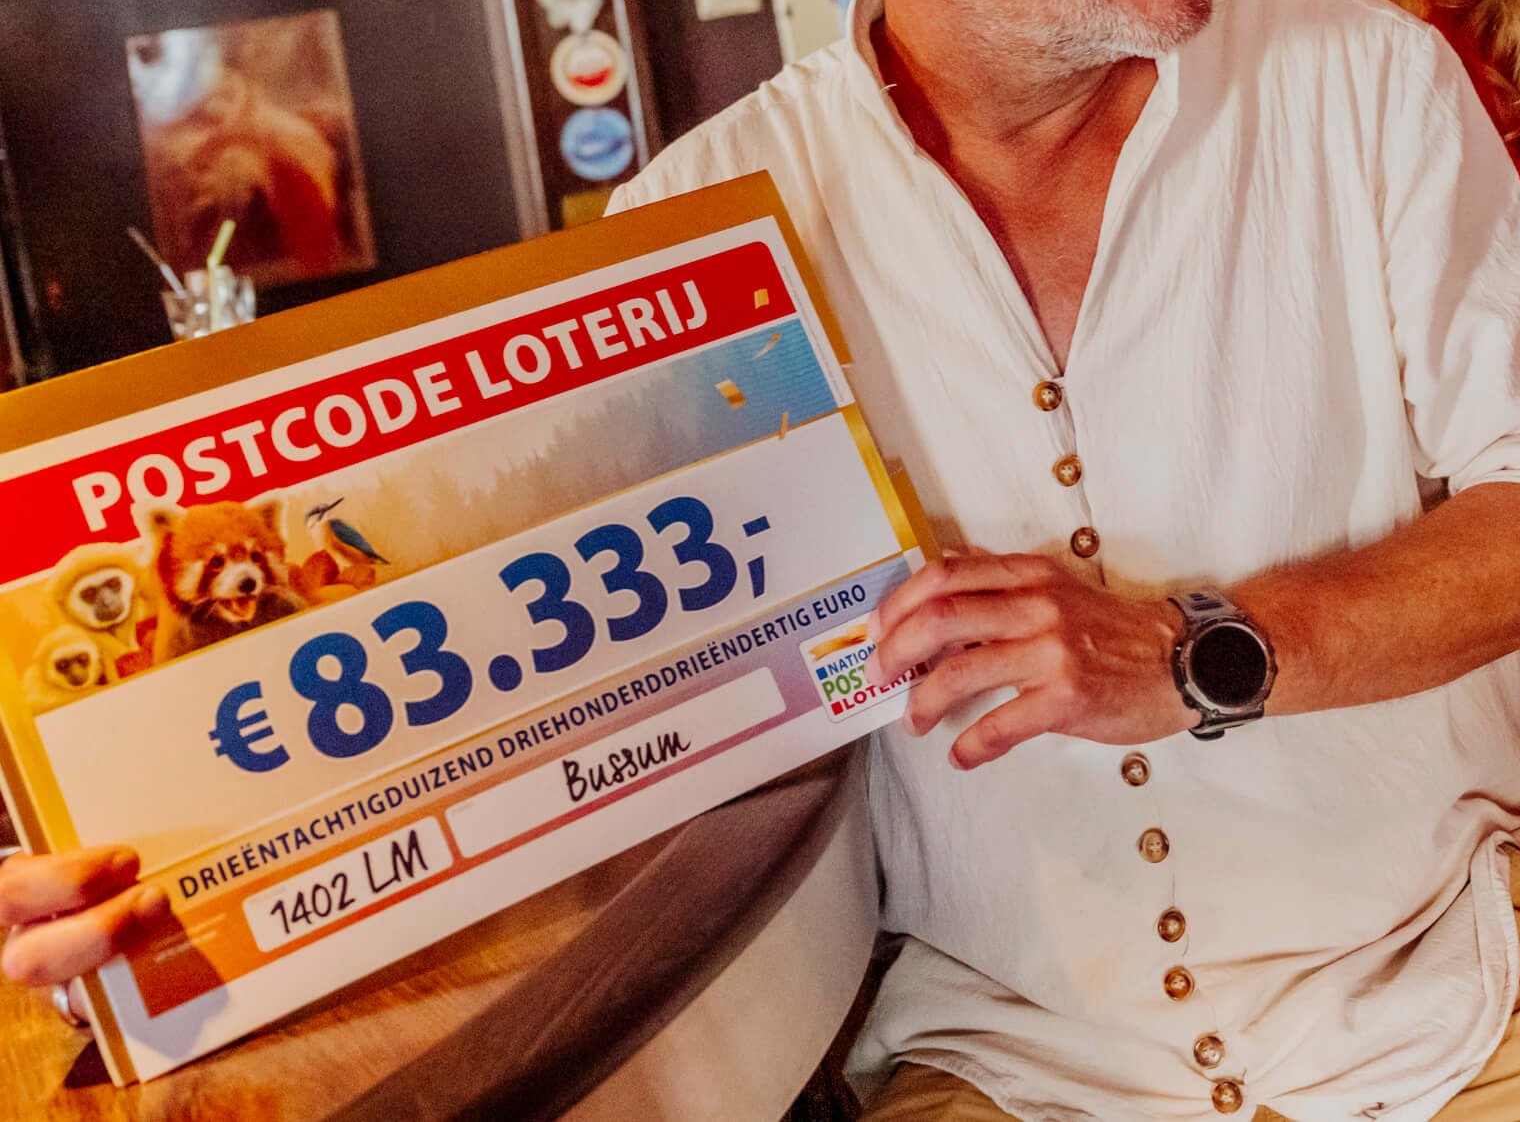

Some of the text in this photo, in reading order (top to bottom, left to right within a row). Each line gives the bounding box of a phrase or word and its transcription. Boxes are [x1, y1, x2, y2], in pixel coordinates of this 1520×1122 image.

[71, 279, 708, 533] POSTCODE LOTERIJ
[178, 584, 867, 900] DRIEËNTACHTIGDUIZEND DRIEHONDERDDRIEËNDERTIG EURO
[562, 730, 695, 803] Bussum
[270, 830, 429, 934] 1402 LM
